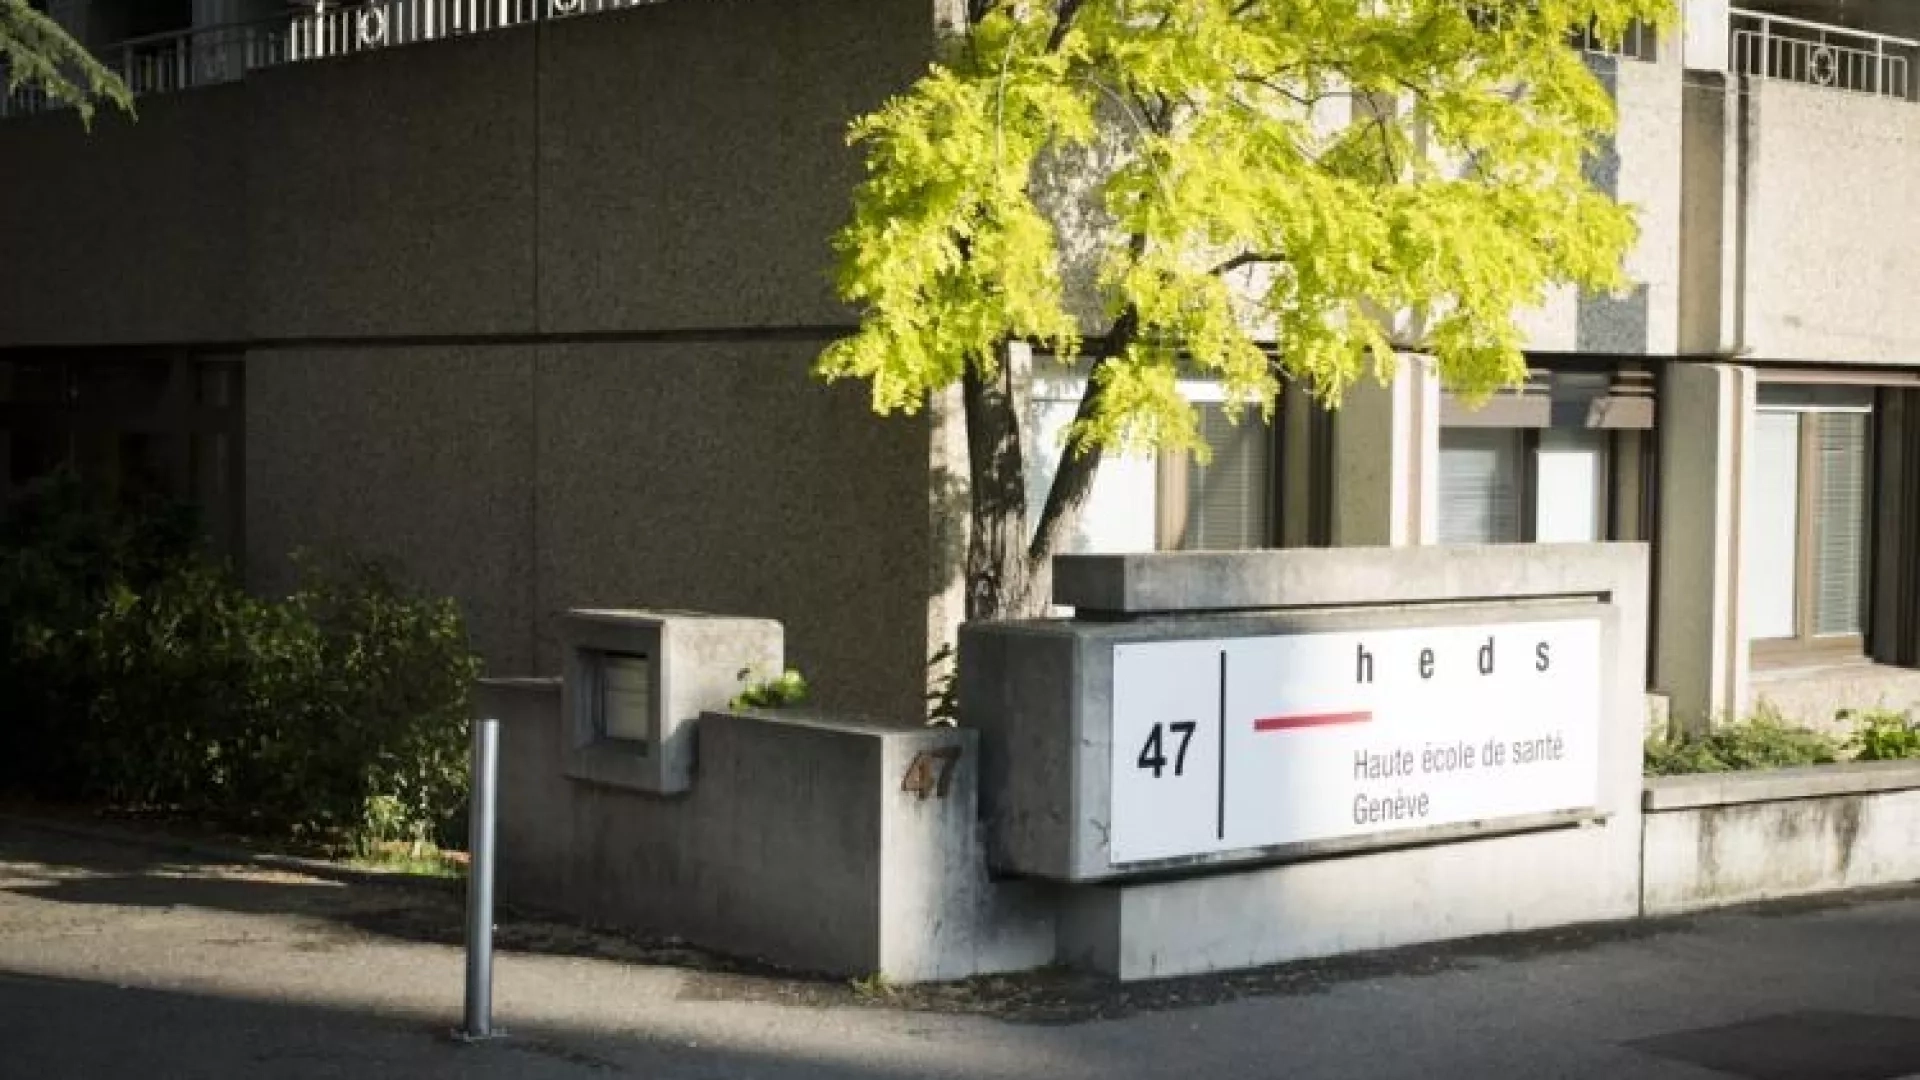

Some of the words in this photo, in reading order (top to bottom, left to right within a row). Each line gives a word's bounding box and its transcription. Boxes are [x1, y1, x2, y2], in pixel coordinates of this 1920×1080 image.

[900, 745, 963, 800] 47
[1136, 720, 1197, 779] 47
[1353, 749, 1414, 780] Haute
[1422, 741, 1475, 774] école
[1482, 737, 1506, 767] de
[1512, 730, 1564, 764] santé
